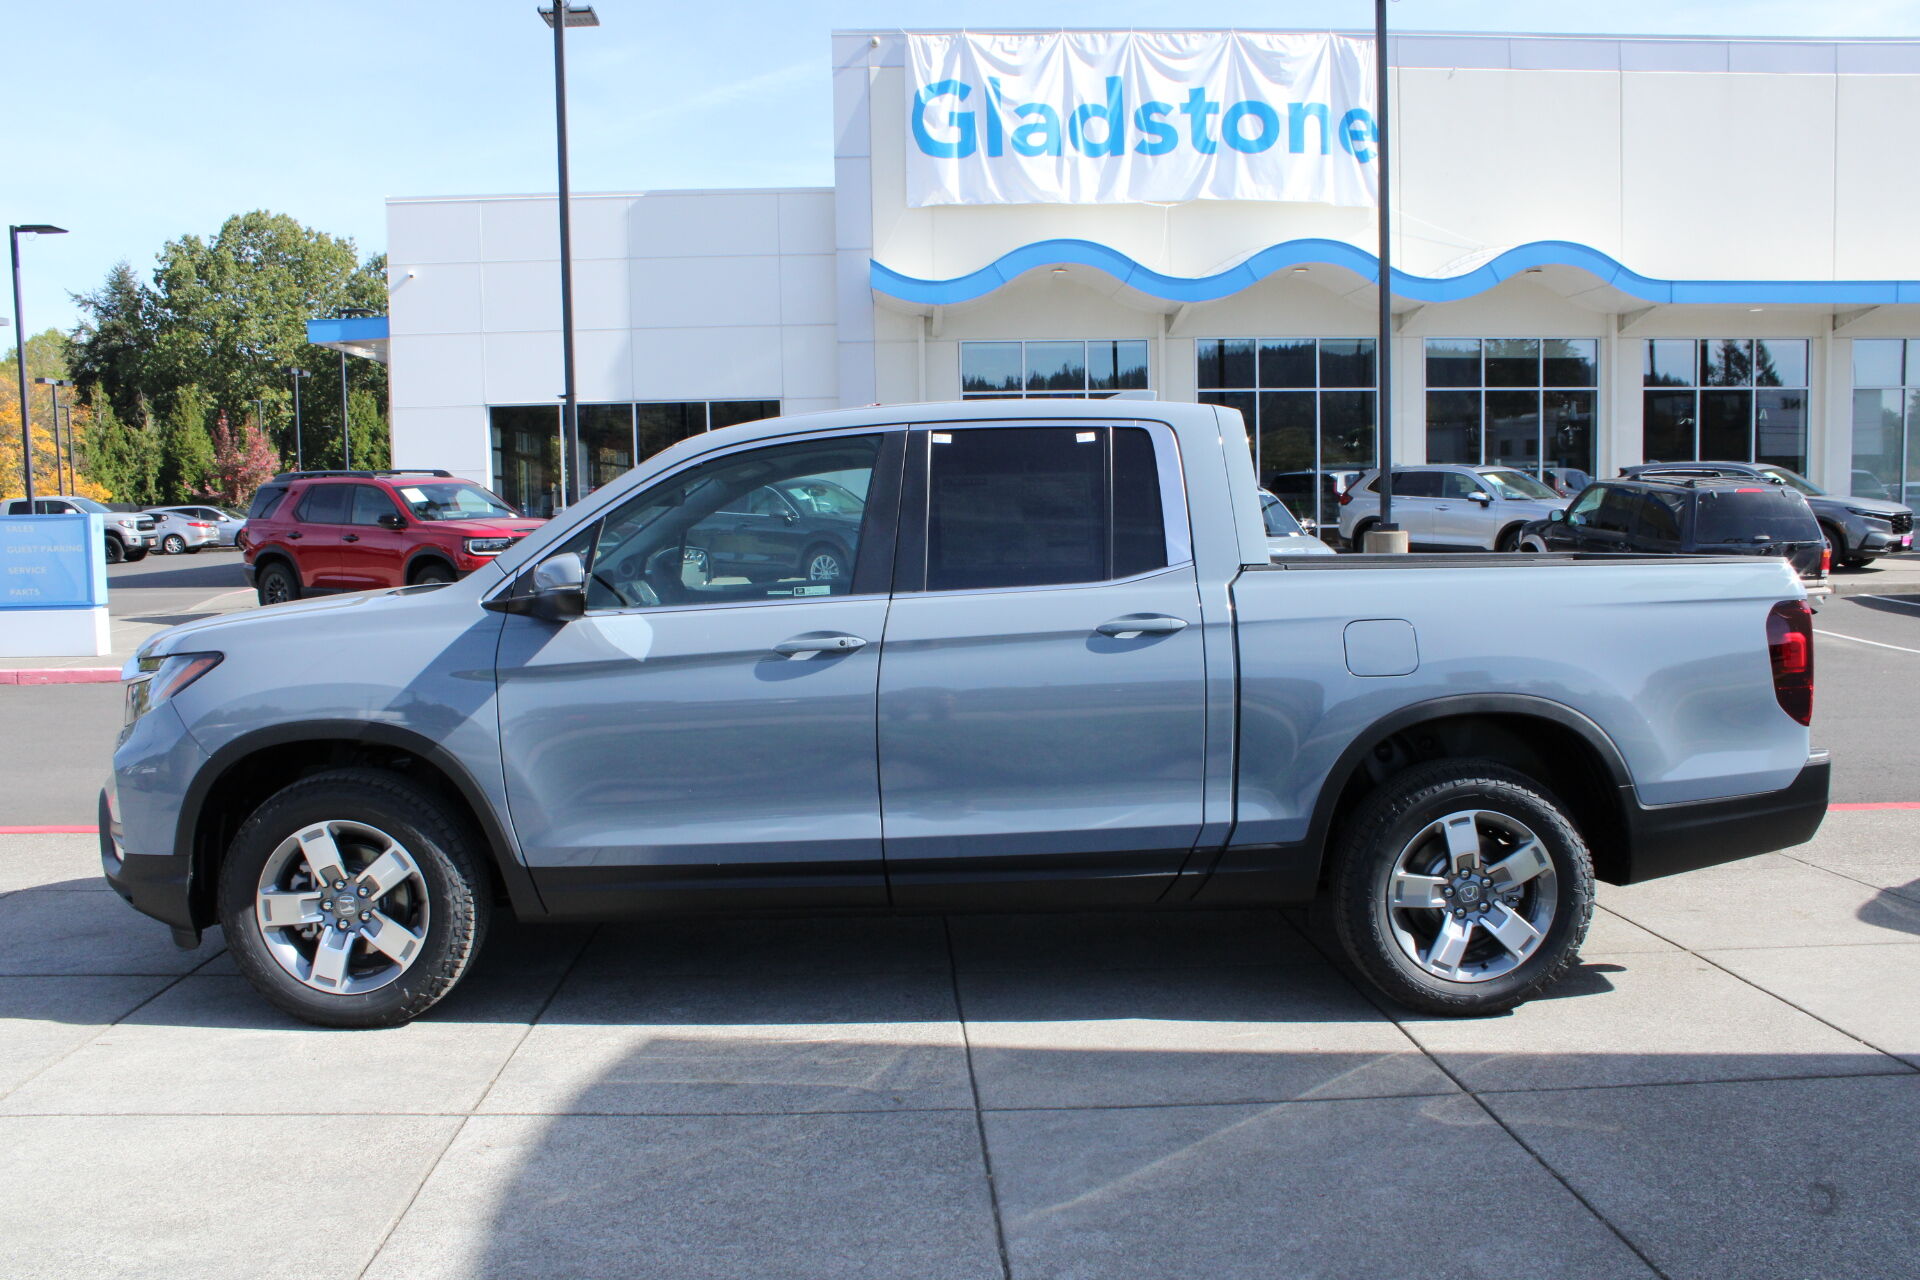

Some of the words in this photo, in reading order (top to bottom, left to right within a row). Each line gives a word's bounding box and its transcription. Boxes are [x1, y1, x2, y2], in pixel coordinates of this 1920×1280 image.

[911, 75, 1379, 164] Gladstone
[6, 524, 34, 533] SALES
[7, 544, 39, 553] GUEST
[41, 543, 83, 553] PARKING
[8, 566, 48, 575] SERVICE
[9, 588, 40, 596] PARTS
